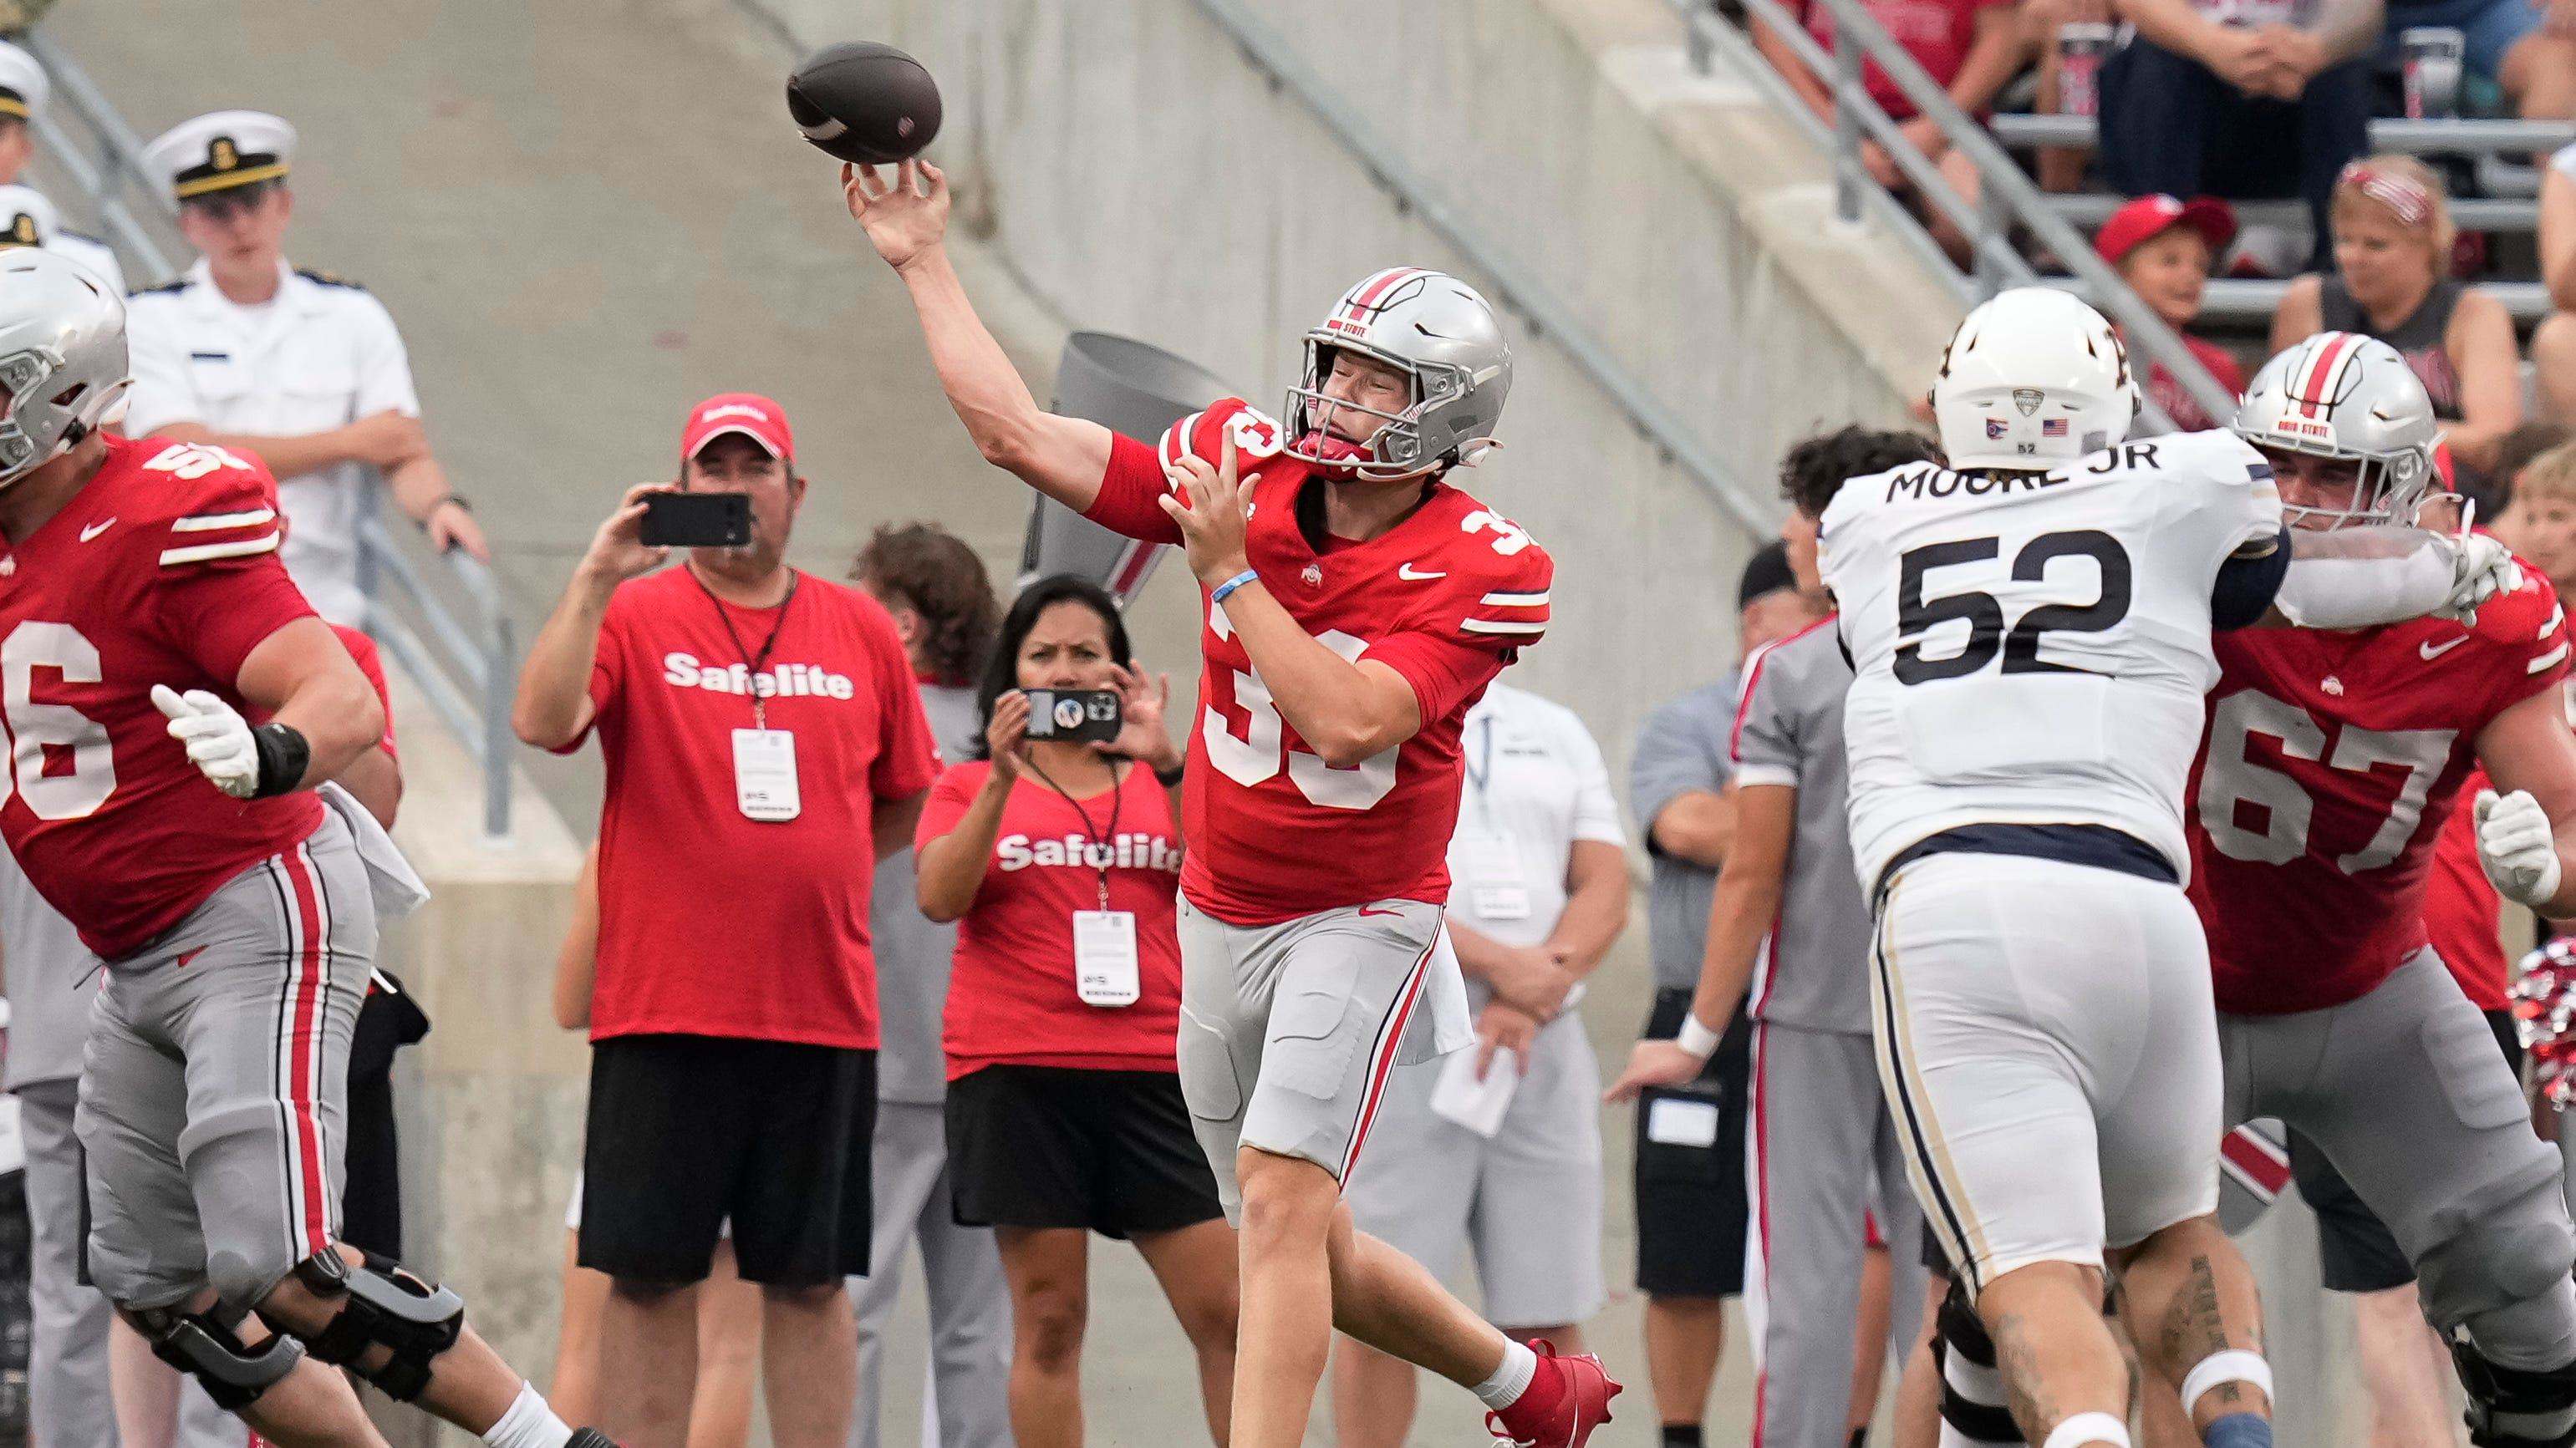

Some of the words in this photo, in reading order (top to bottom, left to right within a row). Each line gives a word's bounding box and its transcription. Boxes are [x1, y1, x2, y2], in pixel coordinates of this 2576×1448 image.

[1222, 406, 1284, 459] 3
[2018, 444, 2036, 454] 52
[2088, 443, 2161, 474] JR
[1461, 506, 1540, 556] 3
[1892, 529, 2132, 686] 52
[664, 652, 854, 700] Safelite
[0, 619, 117, 821] 6
[2198, 688, 2460, 876] 67
